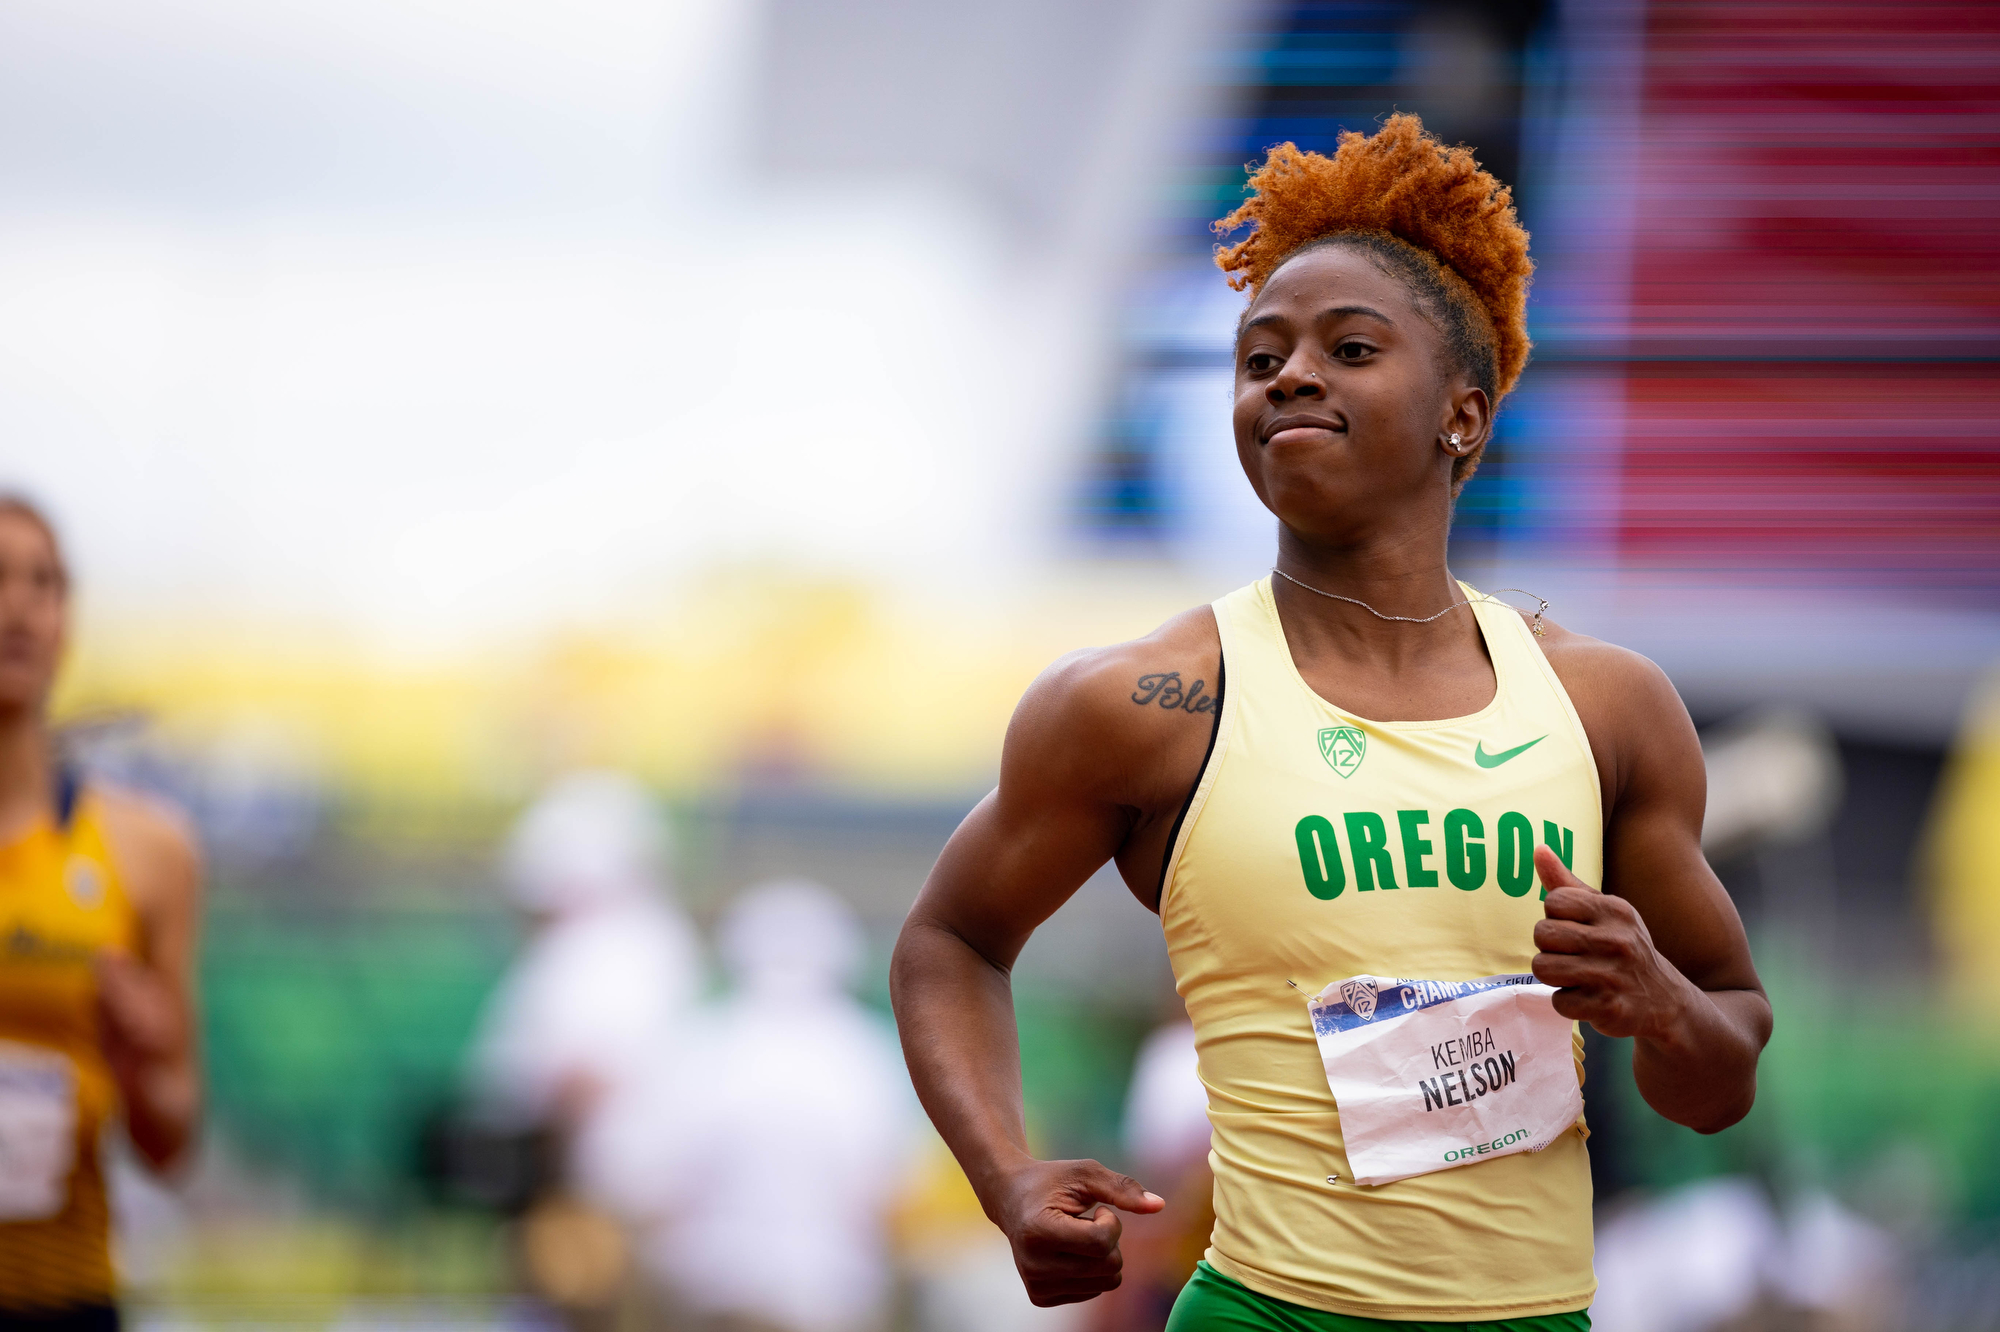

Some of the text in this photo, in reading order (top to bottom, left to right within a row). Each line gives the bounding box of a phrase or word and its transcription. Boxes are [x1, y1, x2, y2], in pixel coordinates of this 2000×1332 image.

[1320, 729, 1363, 757] PAC
[1332, 749, 1355, 767] 12
[1342, 980, 1377, 1007] PAC
[1357, 1000, 1372, 1014] 12
[1430, 1026, 1496, 1070] KEMBA
[1418, 1049, 1516, 1113] NELSON
[1443, 1128, 1529, 1162] OREGON
